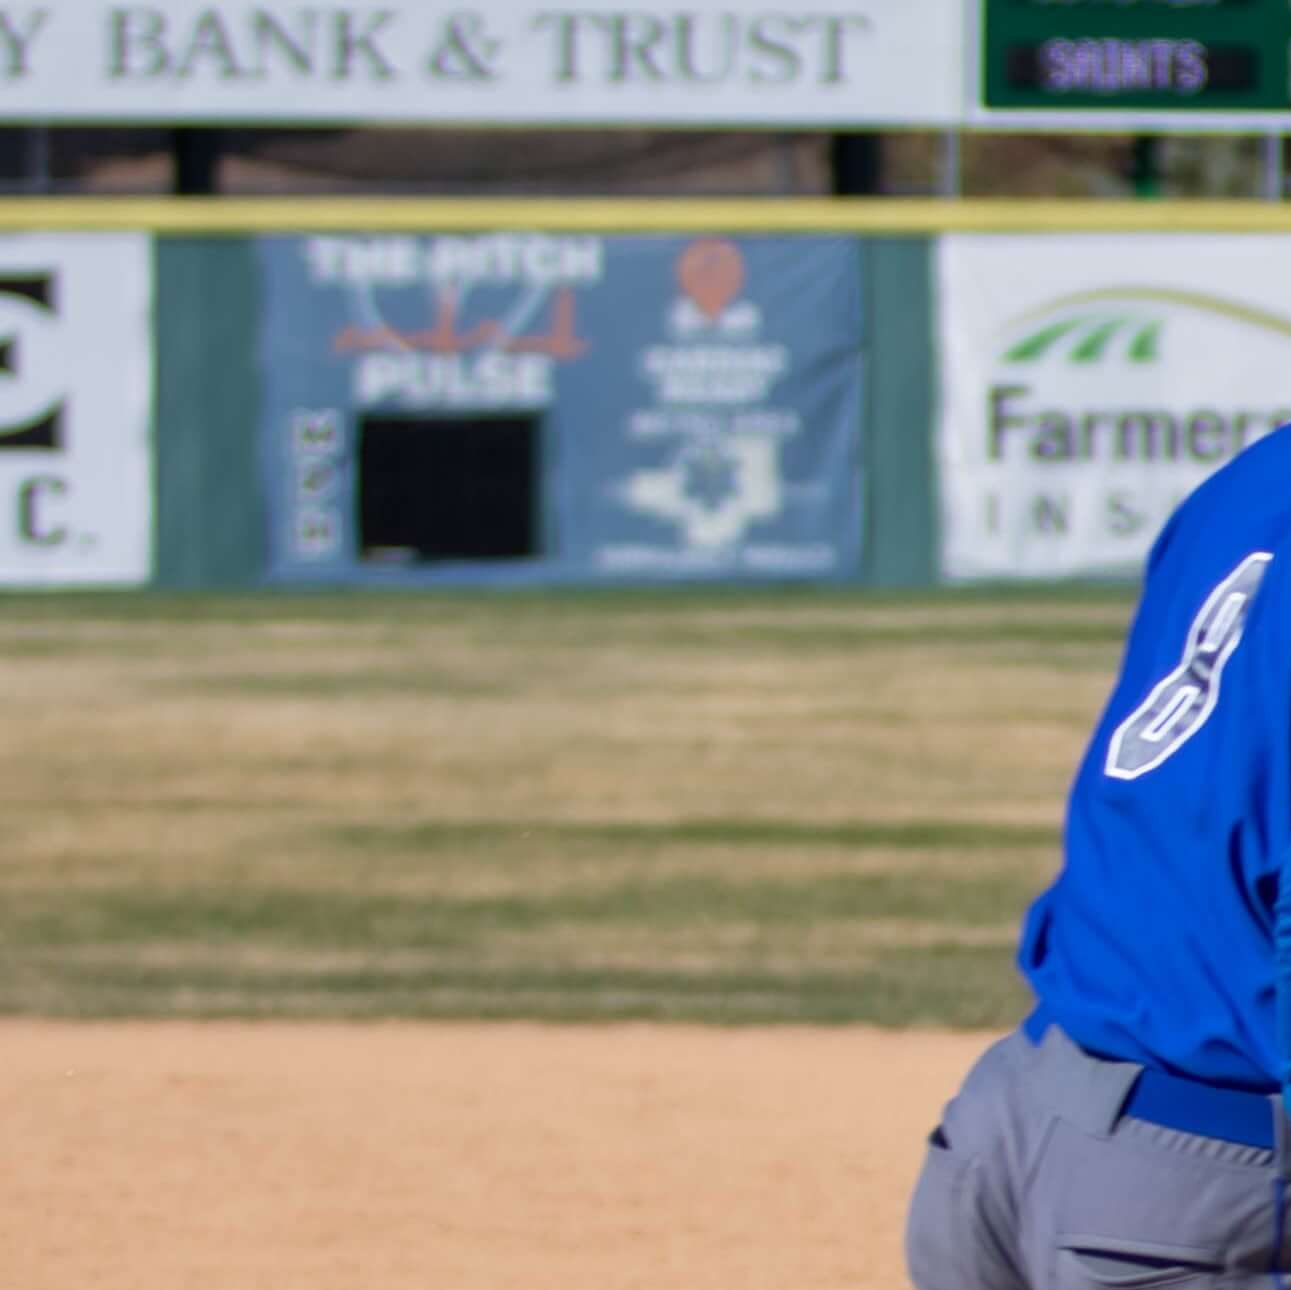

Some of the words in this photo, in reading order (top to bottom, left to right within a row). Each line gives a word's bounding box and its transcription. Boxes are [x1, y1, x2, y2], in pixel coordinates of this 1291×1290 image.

[105, 8, 402, 80] BANK
[428, 8, 500, 82] &
[533, 10, 870, 84] TRUST
[352, 350, 555, 408] PULSE
